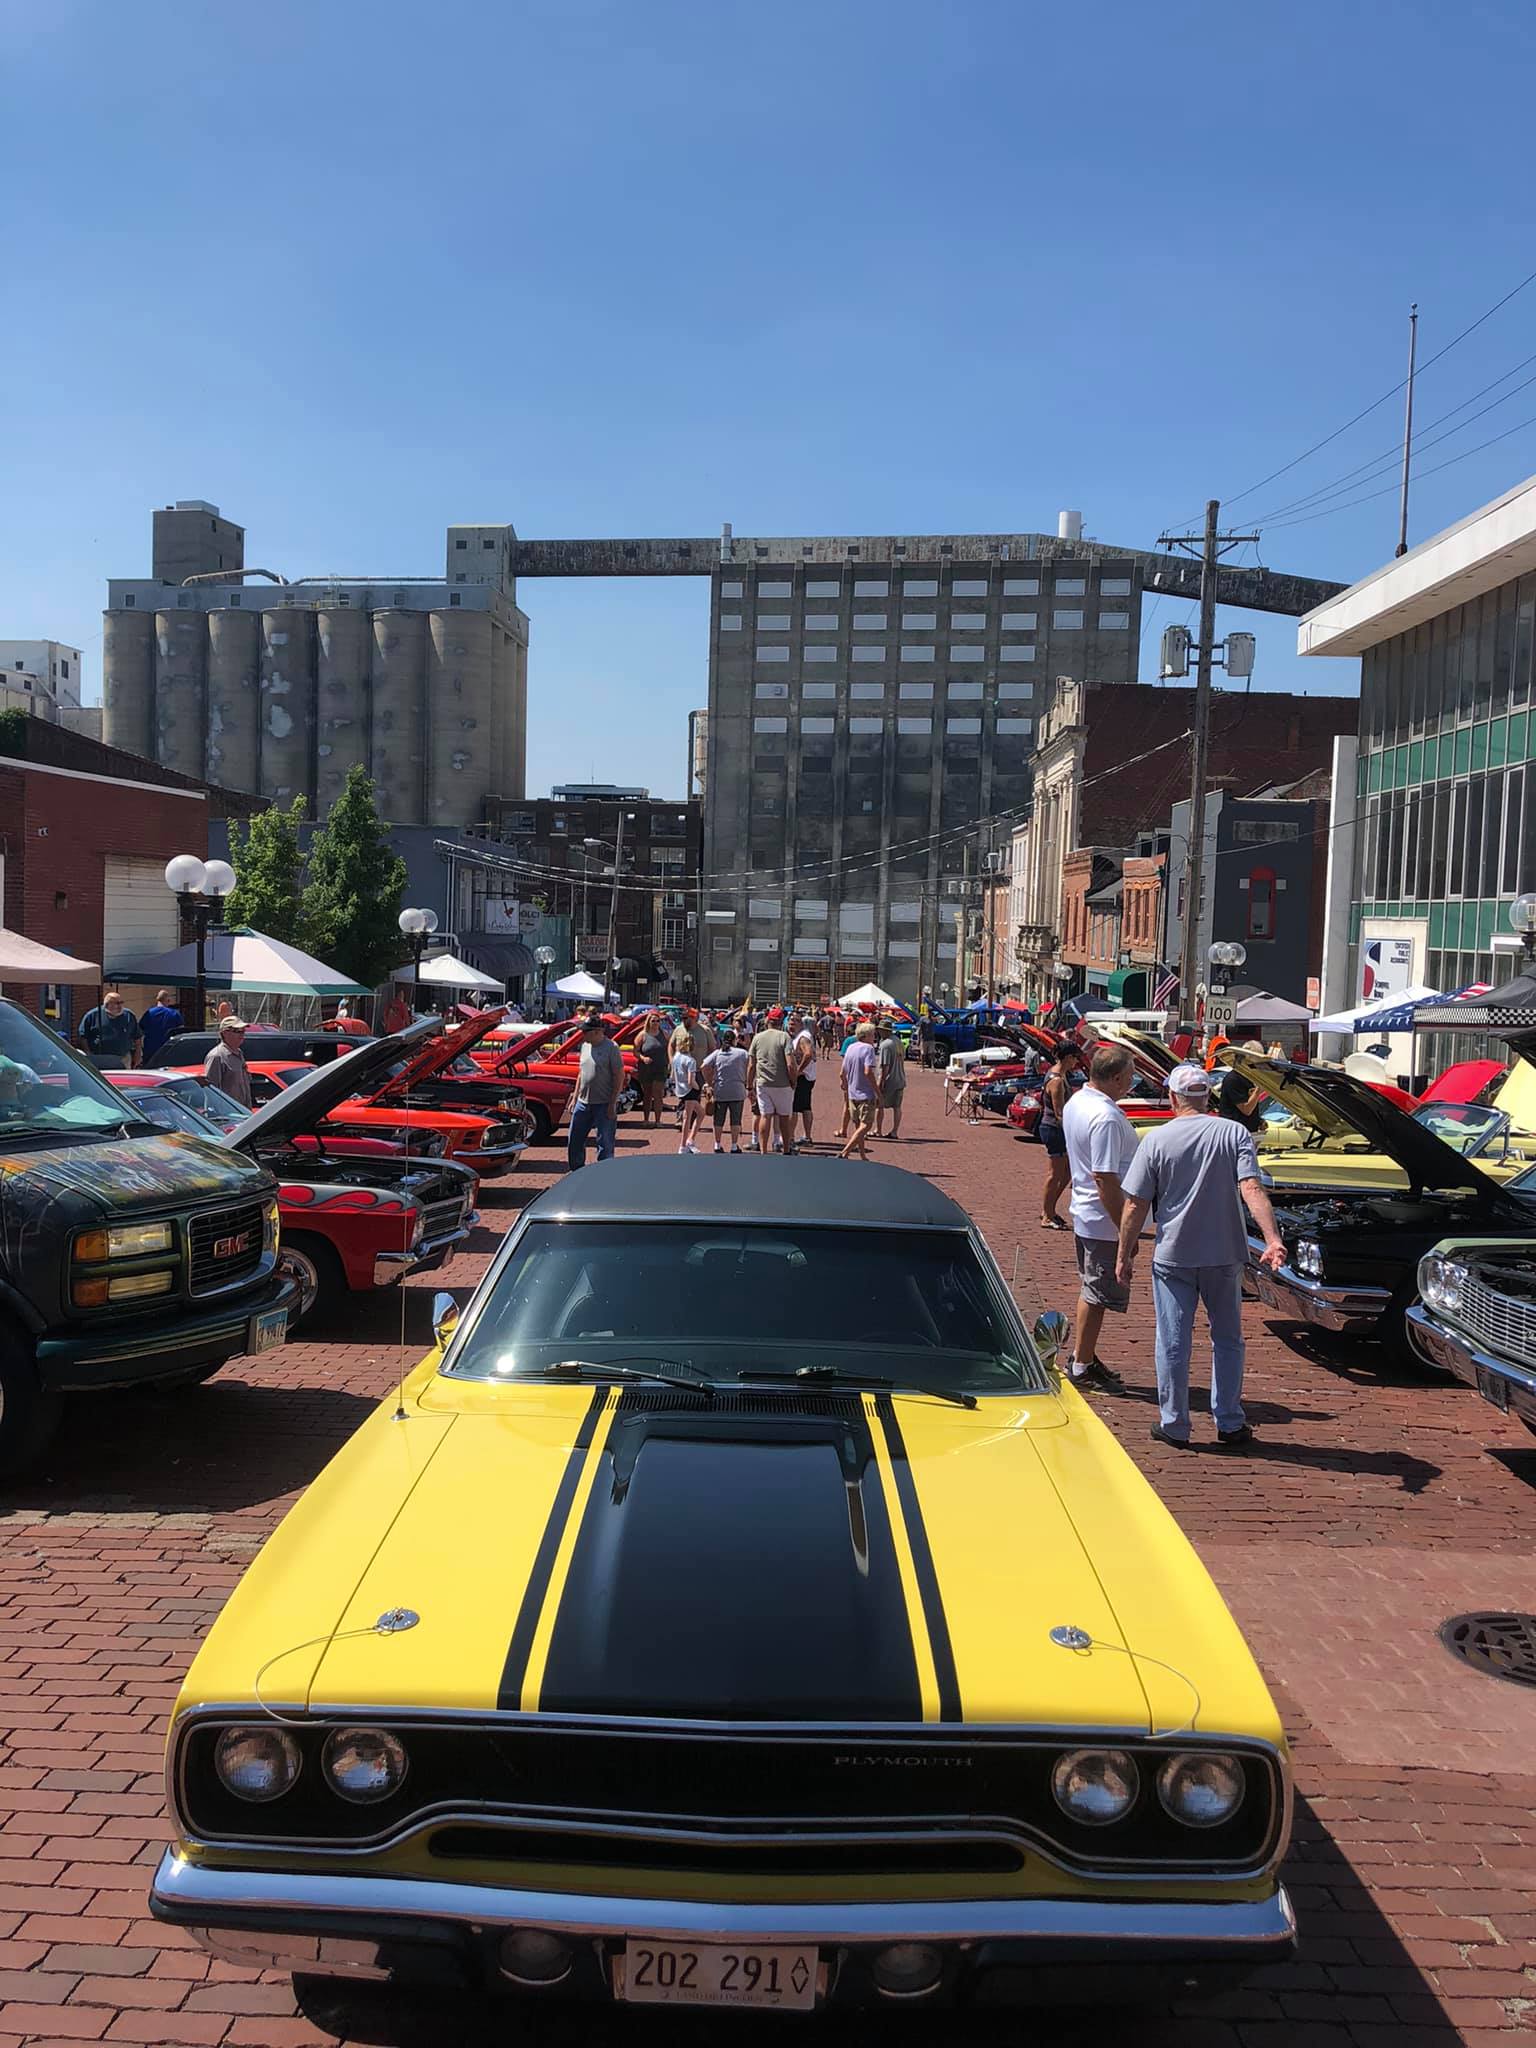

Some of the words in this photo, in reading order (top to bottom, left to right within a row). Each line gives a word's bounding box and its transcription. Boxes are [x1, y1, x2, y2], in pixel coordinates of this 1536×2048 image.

[1210, 1007, 1232, 1021] 100
[214, 1231, 249, 1259] GMC
[833, 1755, 973, 1767] PLYMOUTH
[634, 1949, 698, 1989] 202
[720, 1954, 783, 1994] 291
